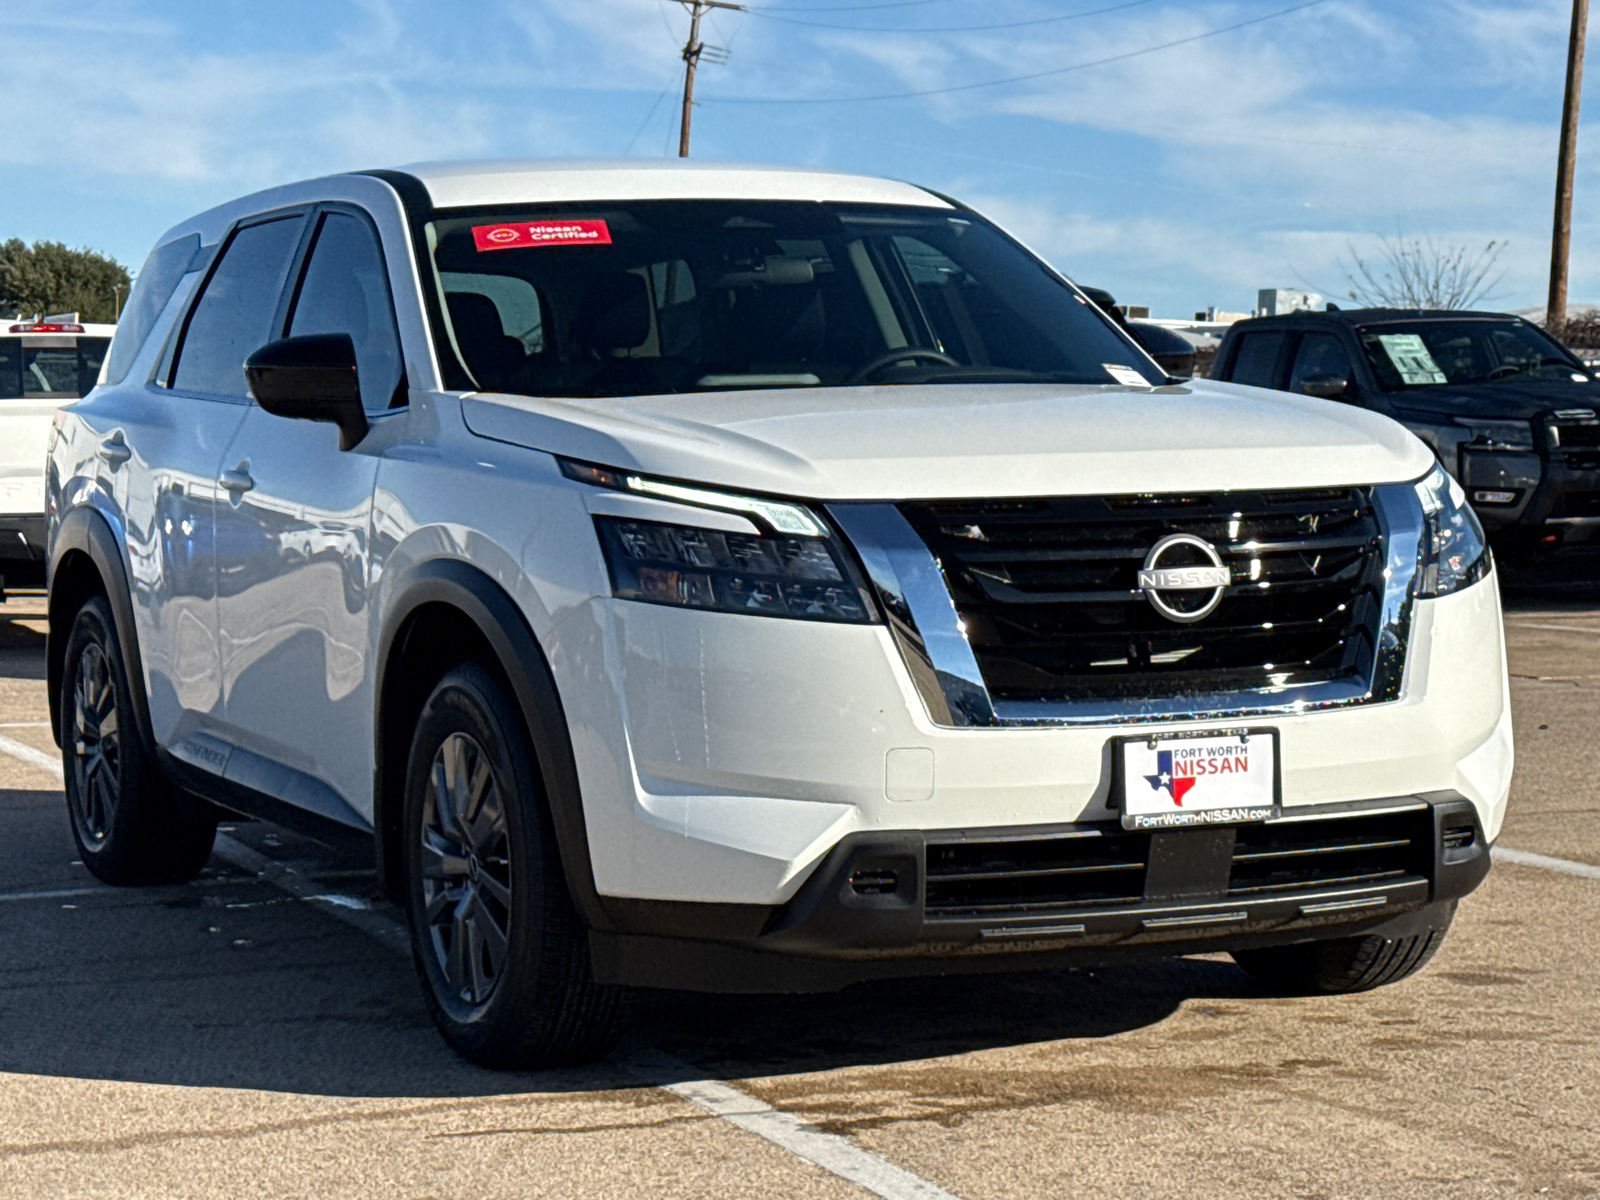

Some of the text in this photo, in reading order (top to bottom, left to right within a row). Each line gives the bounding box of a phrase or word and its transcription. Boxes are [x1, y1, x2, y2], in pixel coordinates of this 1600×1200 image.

[529, 226, 582, 234] Nissan
[531, 230, 599, 241] Certified
[1140, 569, 1228, 587] NISSAN
[1174, 745, 1248, 759] FORT WORTH
[1174, 756, 1248, 776] NISSAN
